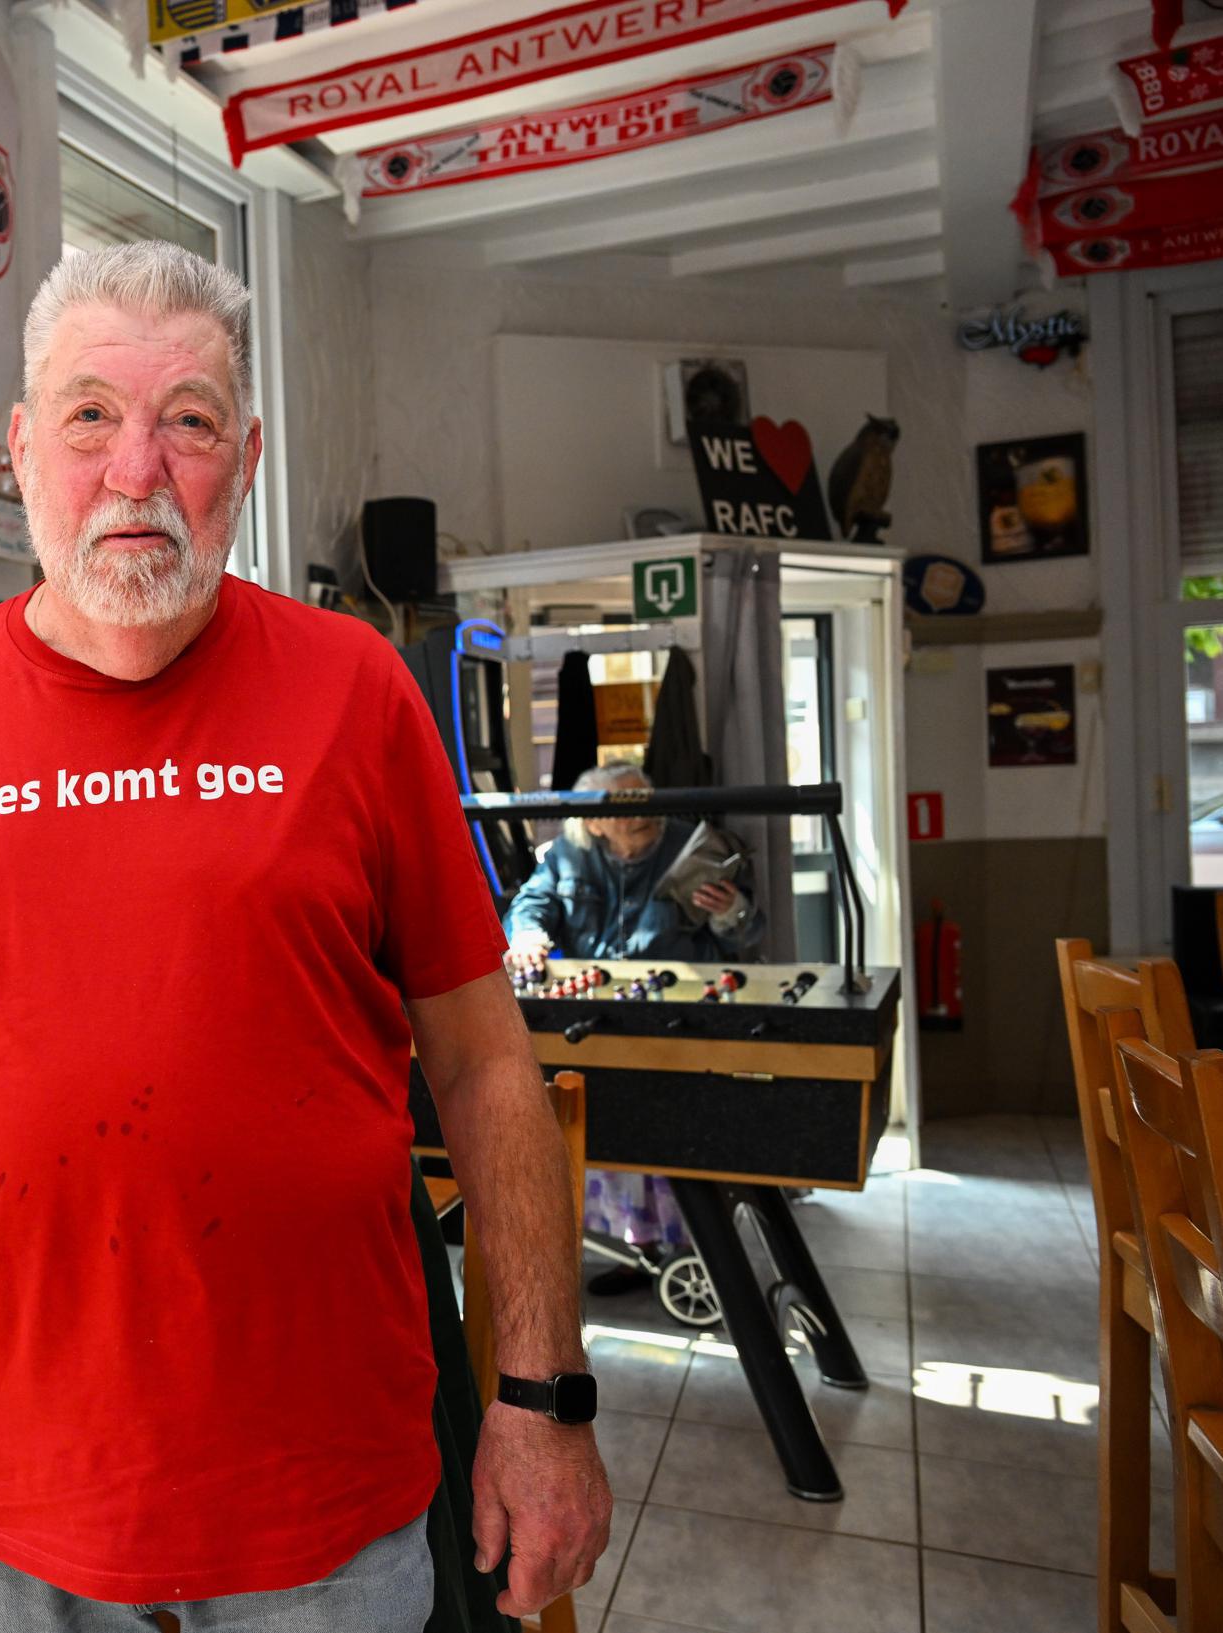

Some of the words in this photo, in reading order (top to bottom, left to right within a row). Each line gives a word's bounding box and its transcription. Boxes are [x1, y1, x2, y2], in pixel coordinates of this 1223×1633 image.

[288, 67, 439, 118] ROYAL
[469, 137, 567, 163] TILL
[585, 131, 598, 148] I
[617, 107, 700, 141] DIE
[498, 98, 669, 142] ANTWERP
[960, 304, 1082, 354] Mystic
[701, 435, 758, 474] WE
[712, 499, 798, 538] RAFC
[57, 758, 179, 807] komt
[196, 762, 283, 800] goe
